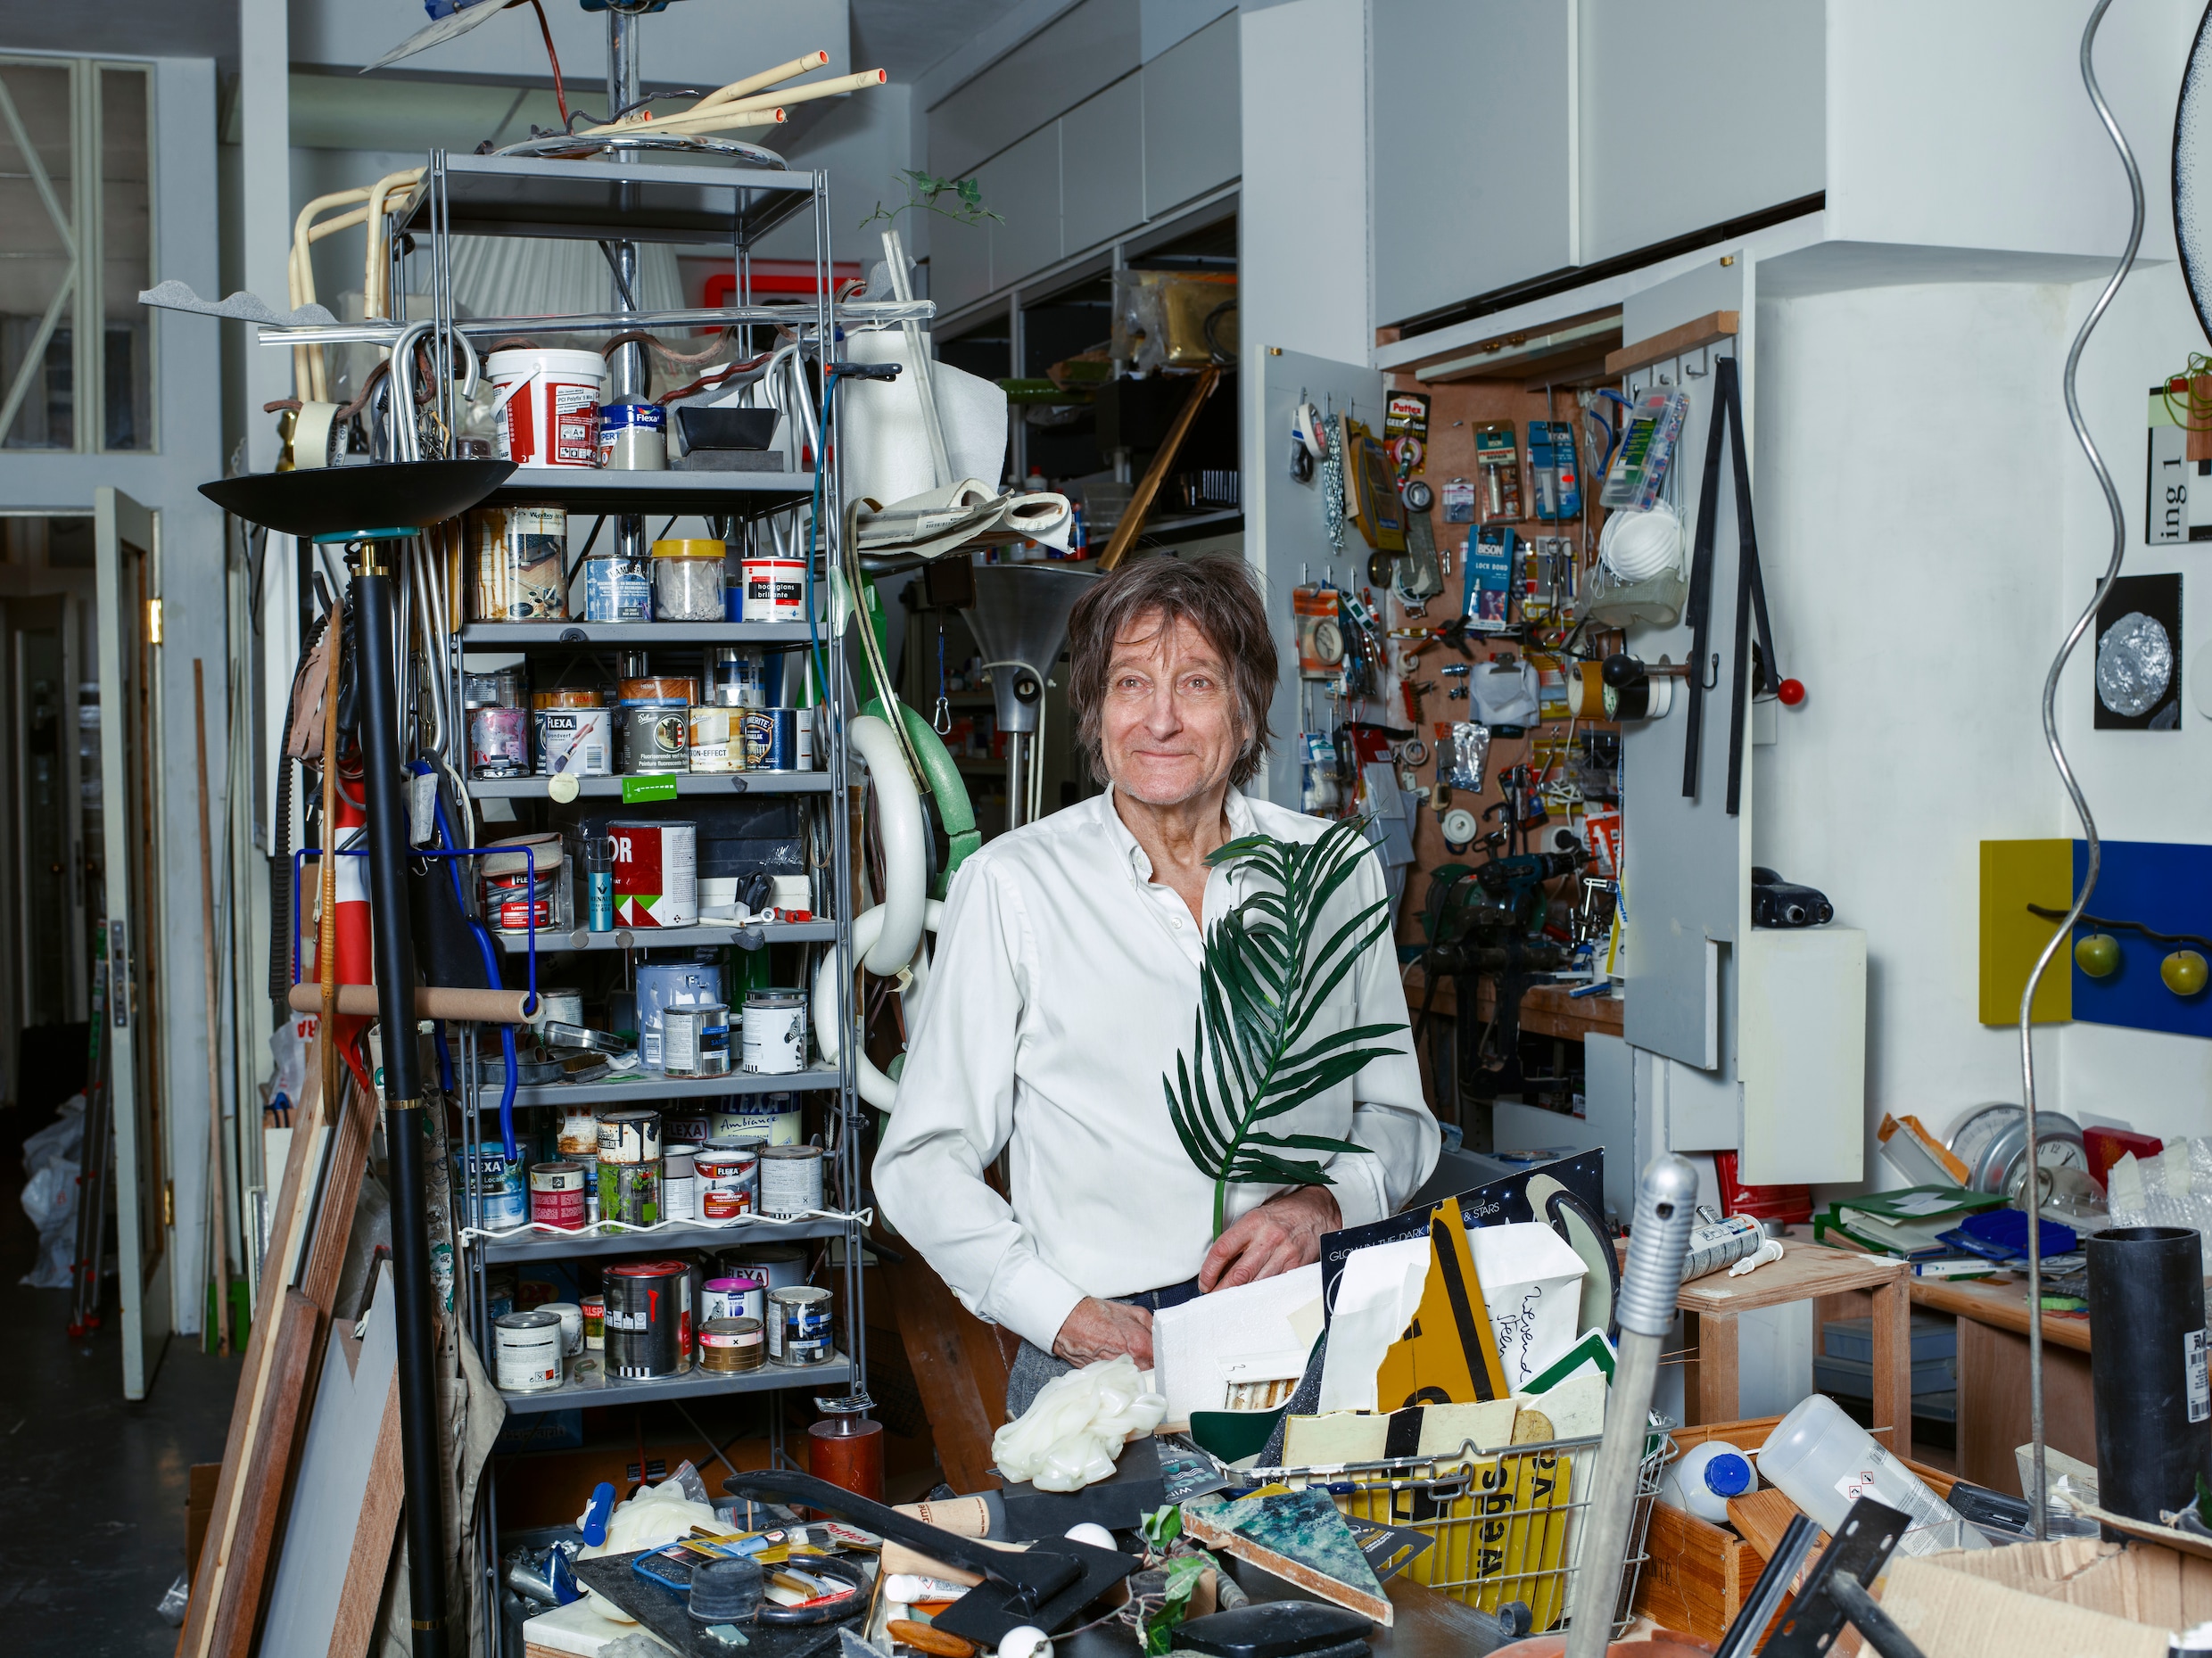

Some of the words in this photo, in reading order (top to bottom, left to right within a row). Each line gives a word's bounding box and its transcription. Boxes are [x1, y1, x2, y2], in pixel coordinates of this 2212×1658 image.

[1393, 402, 1422, 414] Pattex
[636, 413, 657, 423] Flexa
[1479, 449, 1514, 457] PERMANENT
[1477, 542, 1503, 556] BISON
[1475, 562, 1490, 570] LOCK
[1491, 564, 1508, 572] BOND
[757, 583, 795, 591] hooglans
[664, 1122, 703, 1138] FLEXA
[720, 1116, 778, 1133] Ambiance
[2050, 1143, 2060, 1154] 12
[717, 1167, 739, 1175] FLEXA
[1473, 1201, 1500, 1219] STARS
[730, 1306, 745, 1317] ID
[827, 1522, 872, 1544] Pattex
